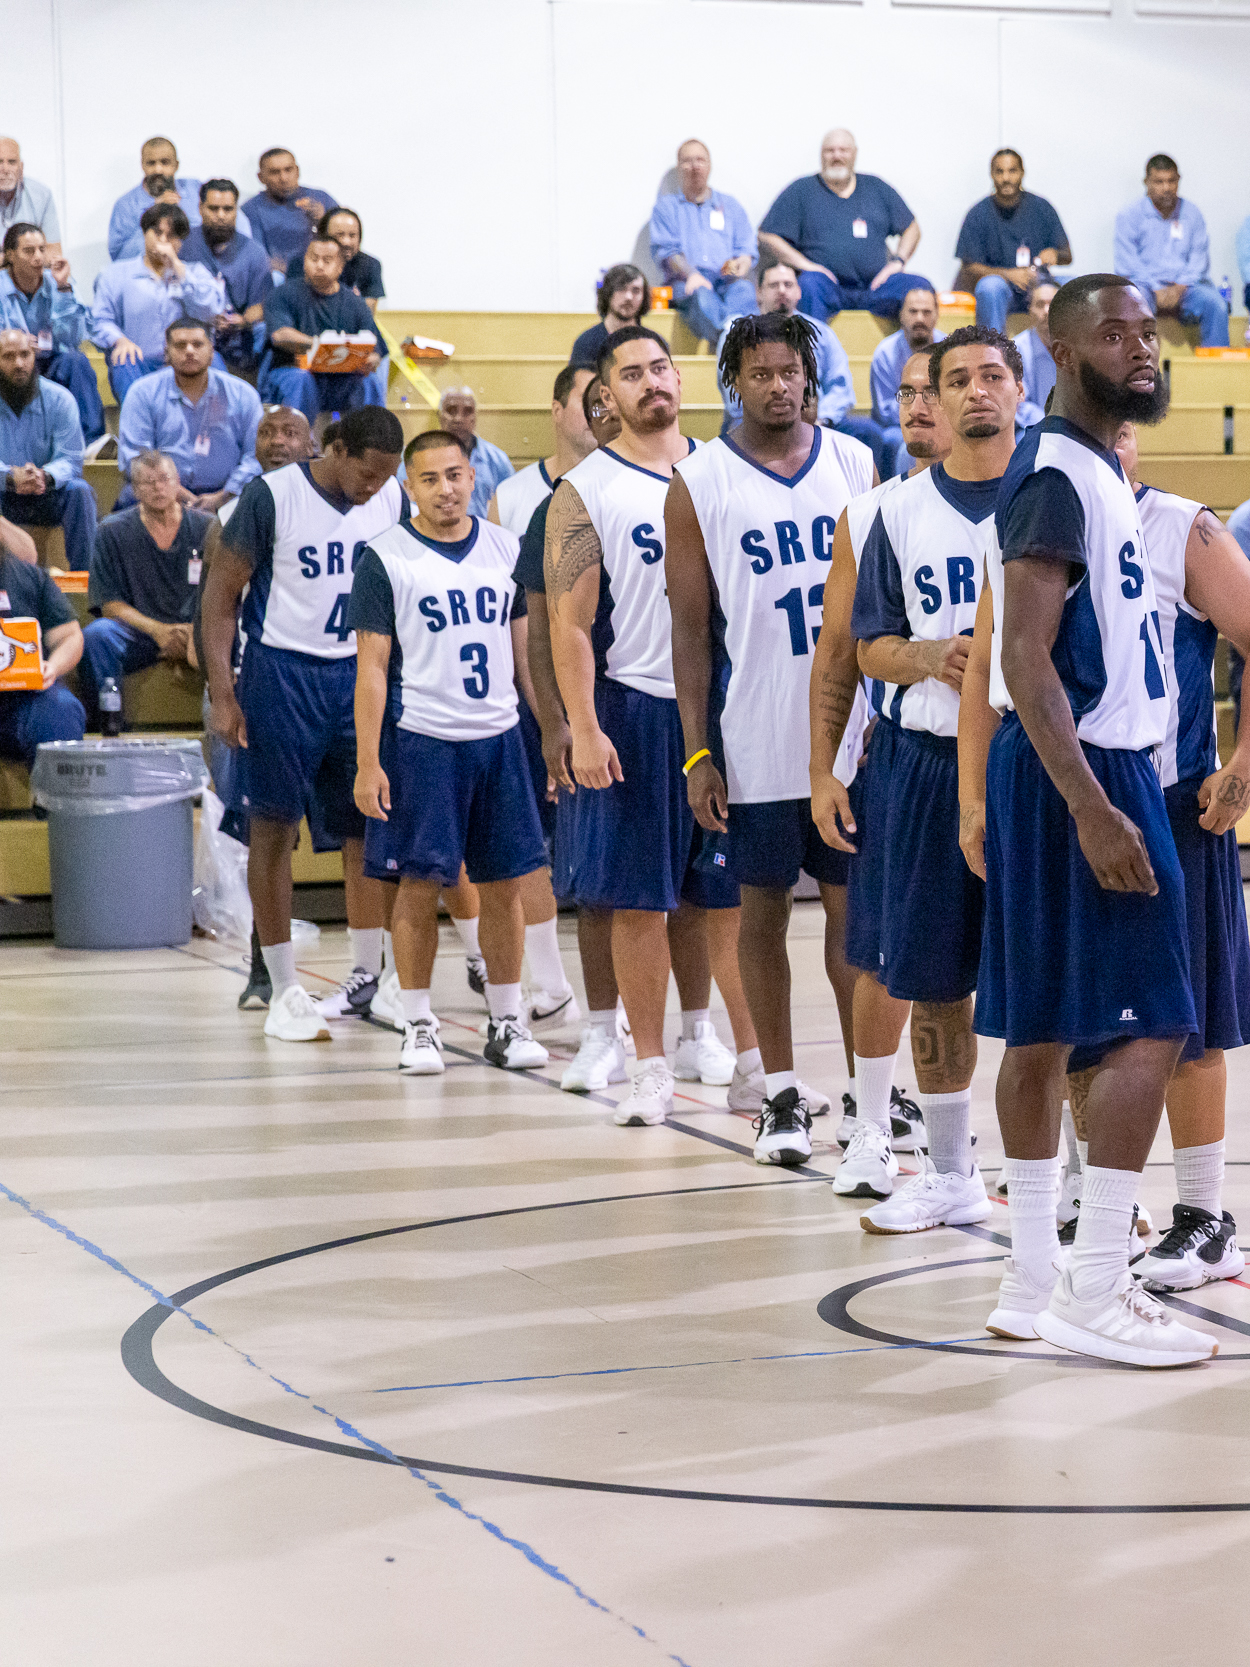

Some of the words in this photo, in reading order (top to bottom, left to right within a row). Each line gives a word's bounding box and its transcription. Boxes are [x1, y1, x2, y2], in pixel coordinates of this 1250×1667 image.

[741, 515, 836, 575] SRC
[1119, 530, 1143, 600] S
[418, 586, 510, 633] SRCI
[914, 556, 976, 615] SR
[324, 593, 352, 642] 4
[460, 642, 490, 699] 3
